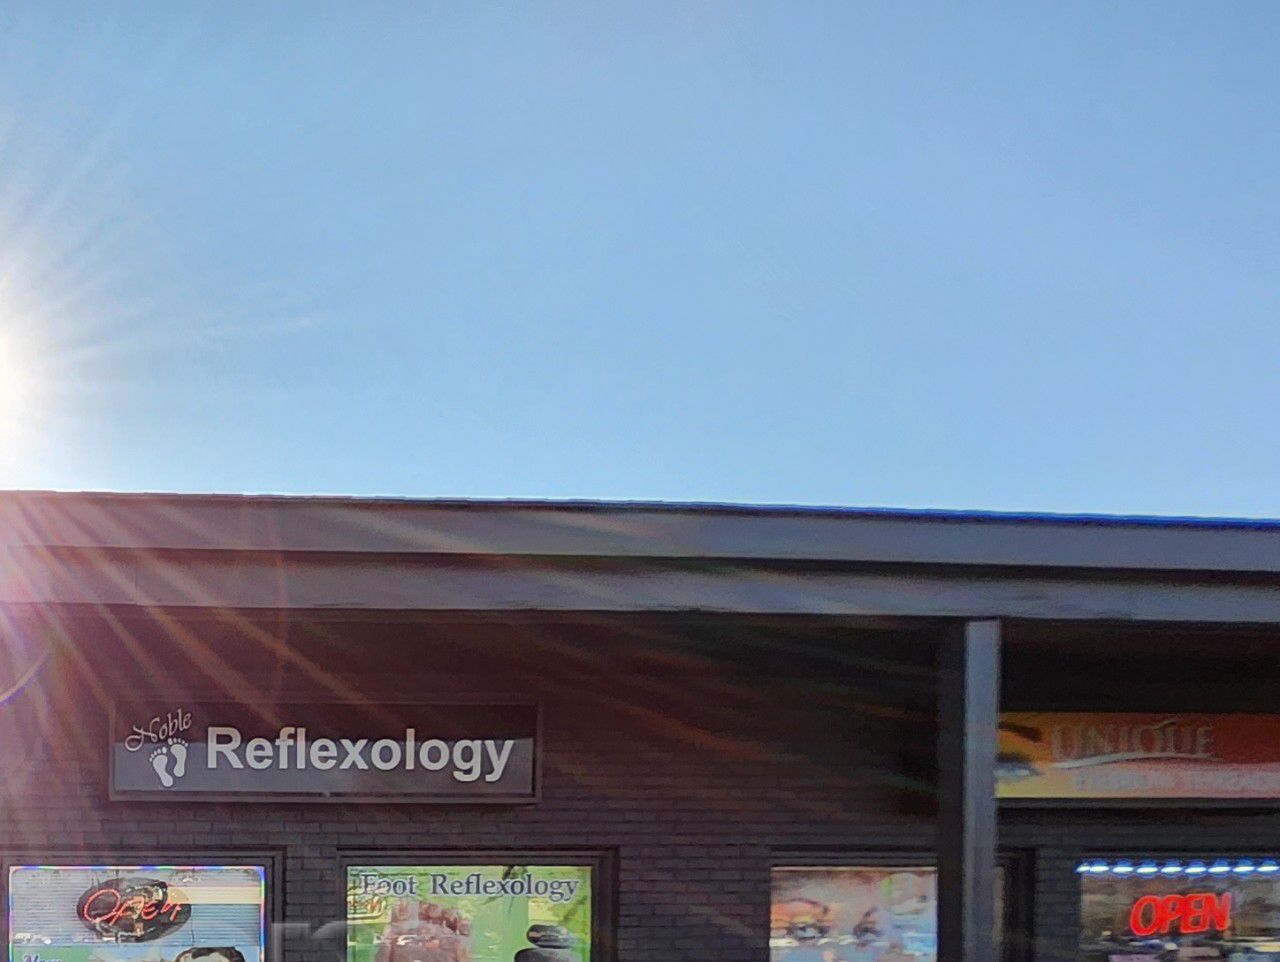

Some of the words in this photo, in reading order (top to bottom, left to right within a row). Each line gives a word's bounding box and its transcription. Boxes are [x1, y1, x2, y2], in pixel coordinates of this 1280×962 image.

[125, 707, 193, 752] Noble
[1052, 718, 1213, 758] UNIQUE
[207, 726, 516, 782] Reflexology
[361, 873, 417, 895] Foot
[430, 873, 580, 900] Reflexology
[1129, 892, 1232, 936] OPEN
